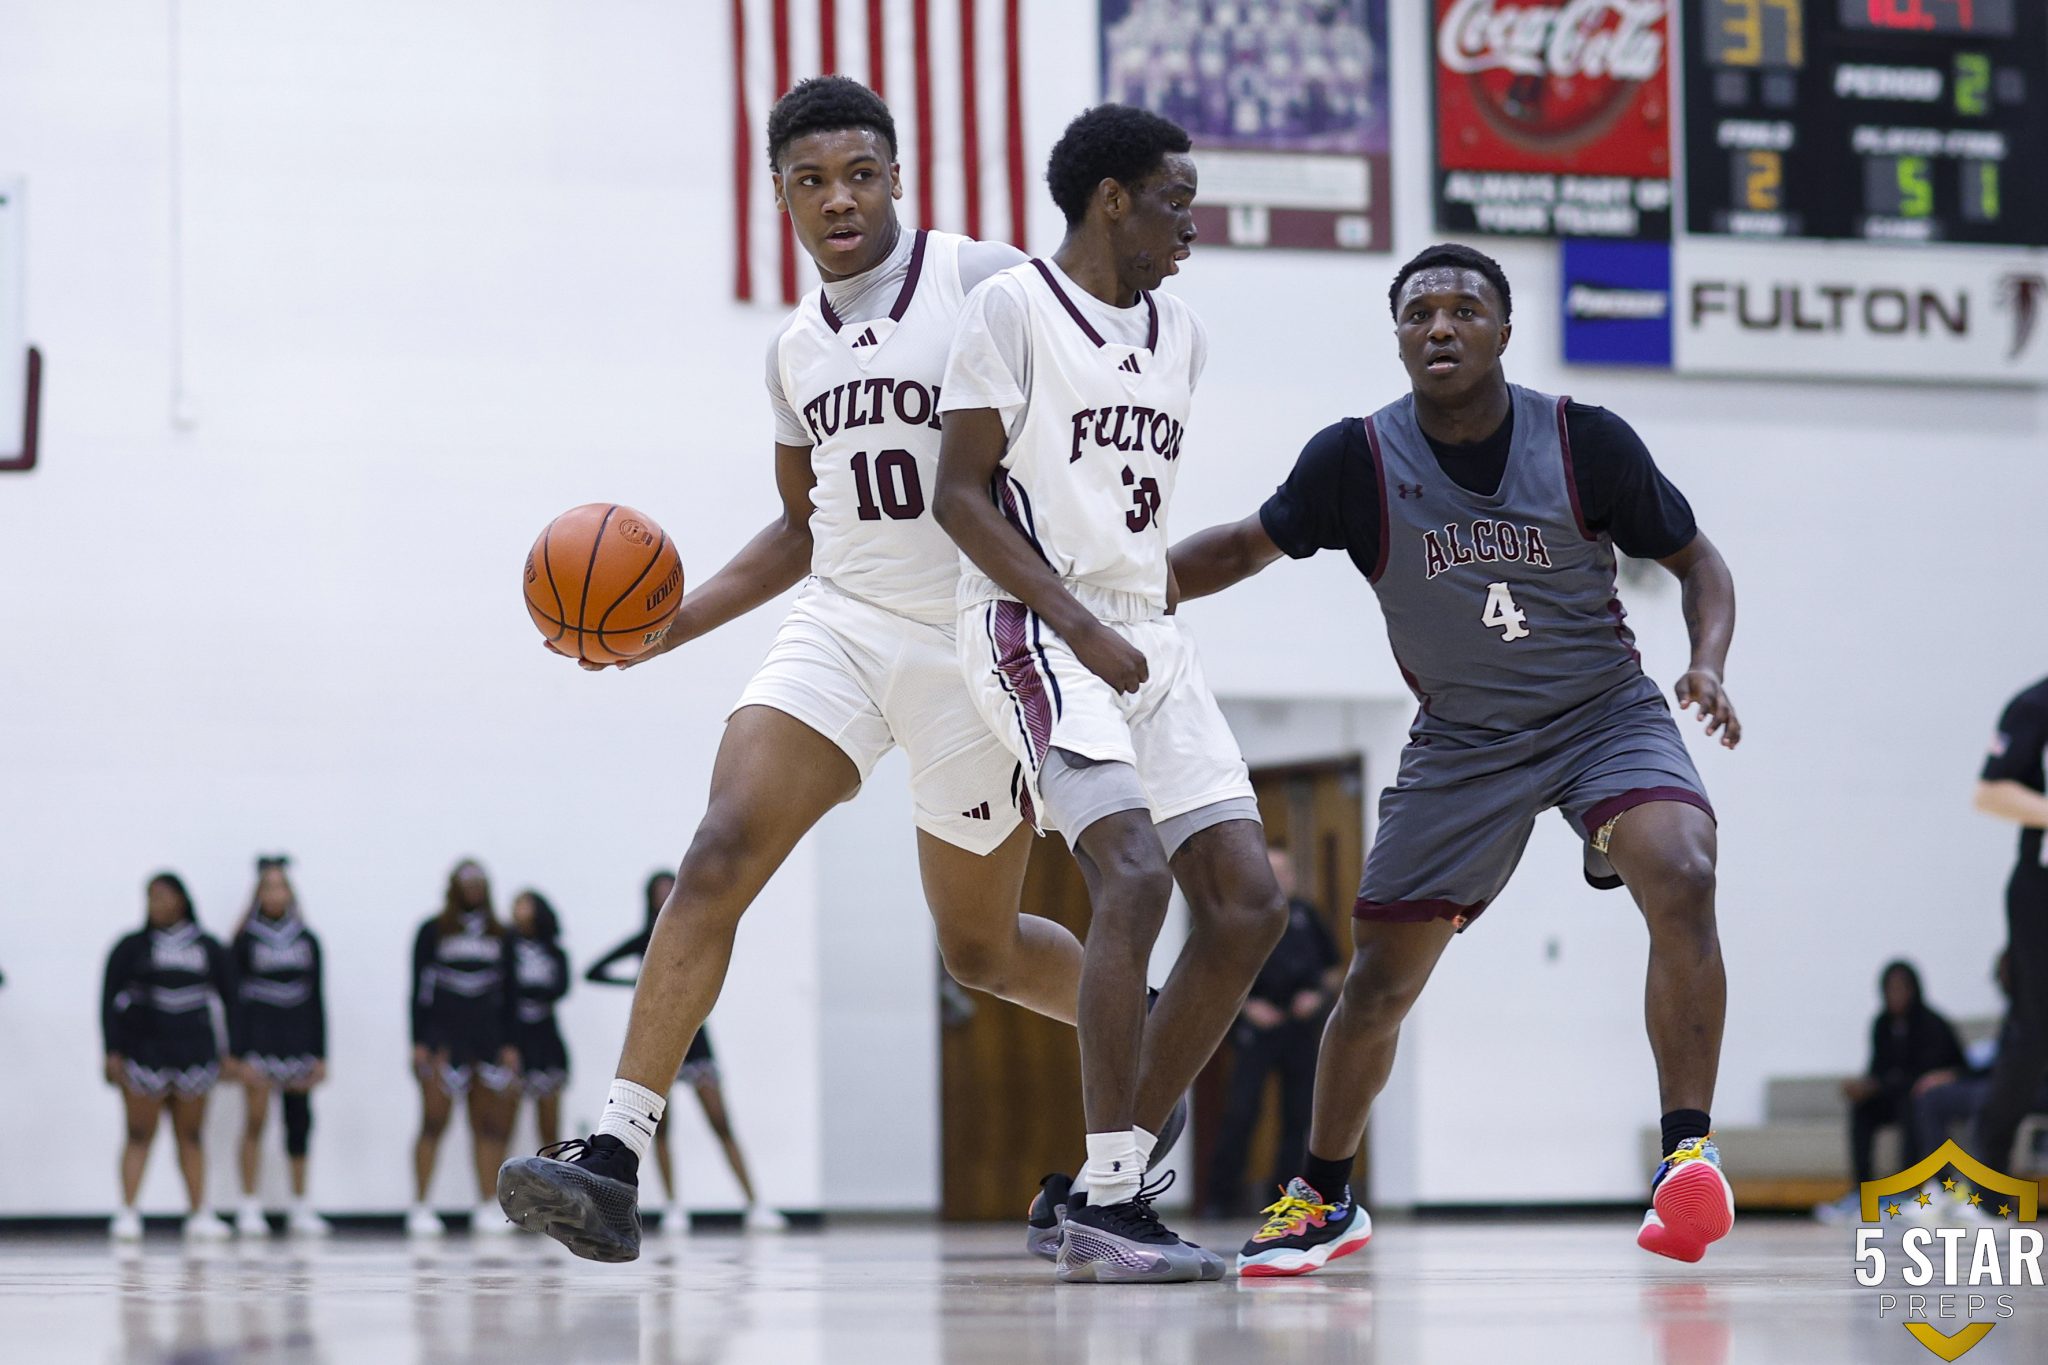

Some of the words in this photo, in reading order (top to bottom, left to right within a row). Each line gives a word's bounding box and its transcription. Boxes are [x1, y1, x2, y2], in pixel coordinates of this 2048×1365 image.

[1722, 0, 1804, 67] 37
[1835, 64, 1943, 102] PERIOD
[1955, 54, 1990, 116] 2
[1445, 171, 1555, 201] ALWAYS
[1561, 175, 1633, 206] PART
[1635, 178, 1671, 211] OF
[1746, 151, 1782, 210] 2
[1896, 156, 1933, 217] 5
[1475, 202, 1550, 233] YOUR
[1690, 281, 1968, 336] FULTON
[1069, 405, 1184, 464] FULTON
[850, 449, 925, 521] 10
[1423, 519, 1552, 580] ALCOA
[1480, 581, 1531, 643] 4
